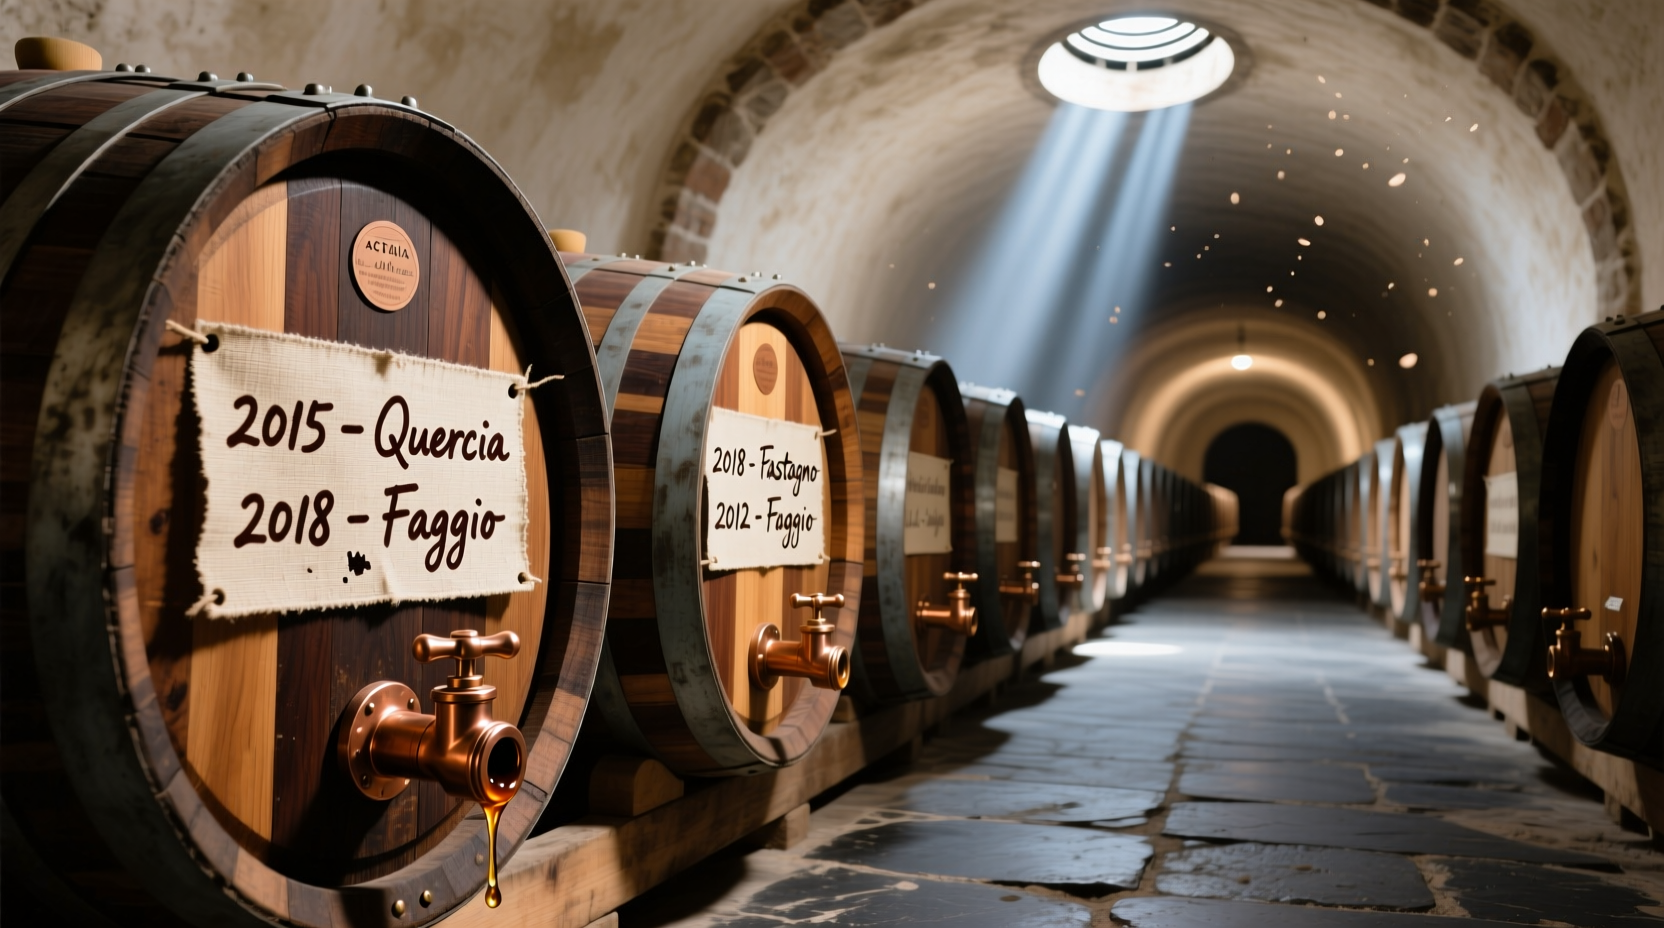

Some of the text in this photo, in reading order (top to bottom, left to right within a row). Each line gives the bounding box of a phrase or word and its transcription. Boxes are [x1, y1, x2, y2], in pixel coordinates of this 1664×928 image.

[227, 394, 334, 453] 2015
[374, 395, 510, 469] Quercia
[712, 446, 746, 477] 2018
[759, 444, 820, 497] Fastagno
[233, 489, 335, 548] 2018
[382, 483, 505, 572] Faggio
[714, 502, 751, 530] 2012
[767, 496, 817, 549] Faggio
